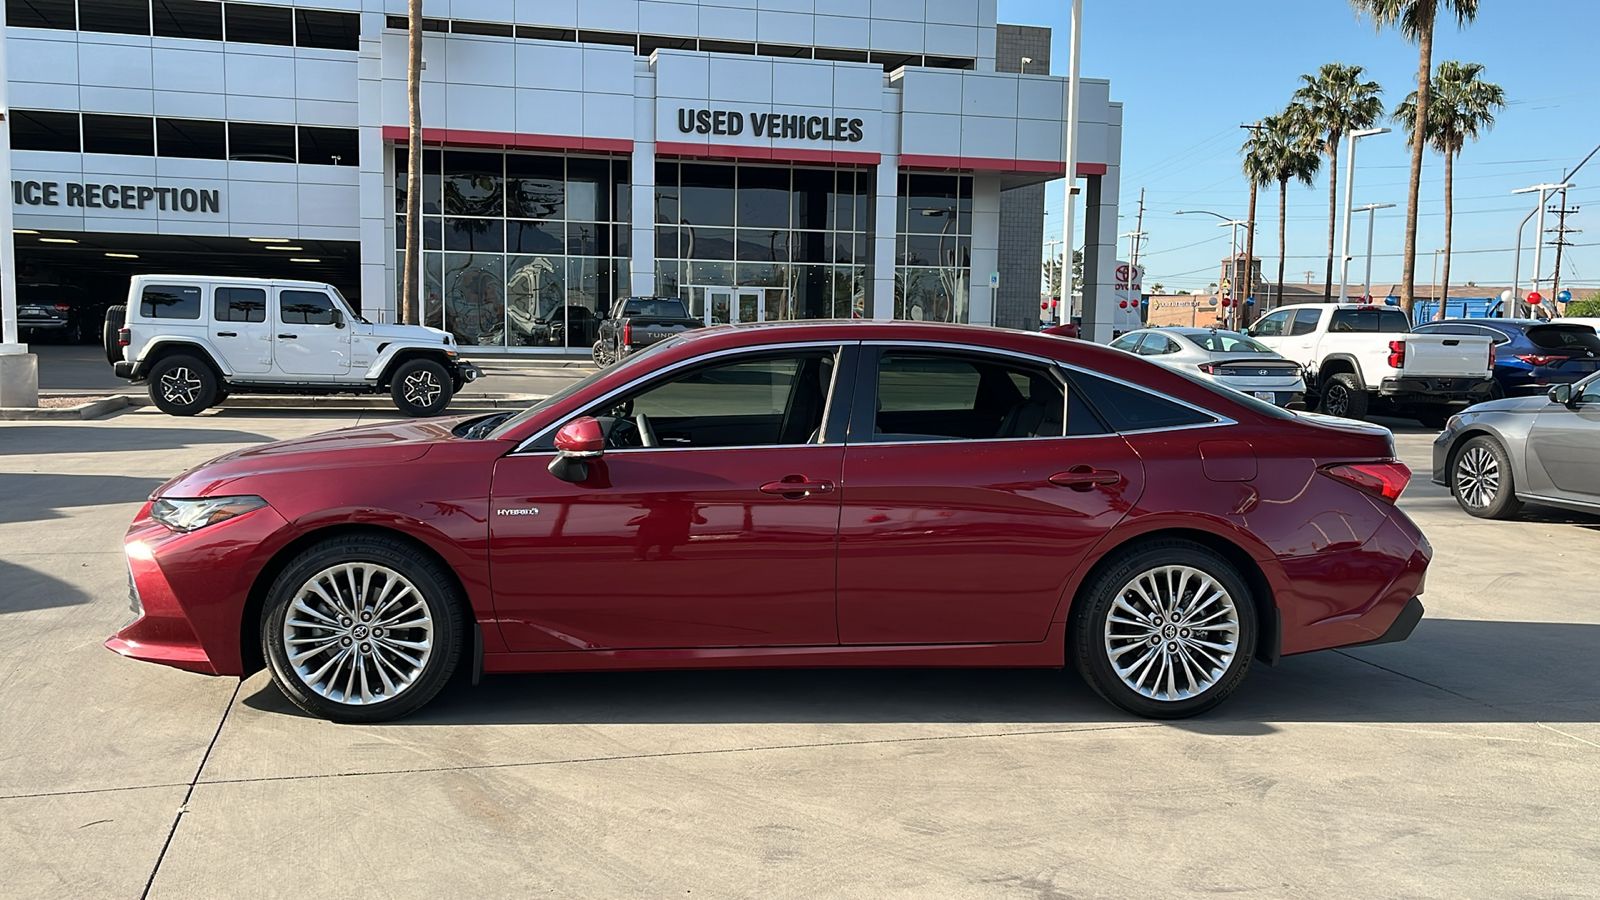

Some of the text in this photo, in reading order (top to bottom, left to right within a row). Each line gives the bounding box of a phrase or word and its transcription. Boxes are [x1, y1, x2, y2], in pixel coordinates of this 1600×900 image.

[678, 108, 863, 142] USED VEHICLES
[11, 180, 219, 213] ICE RECEPTION
